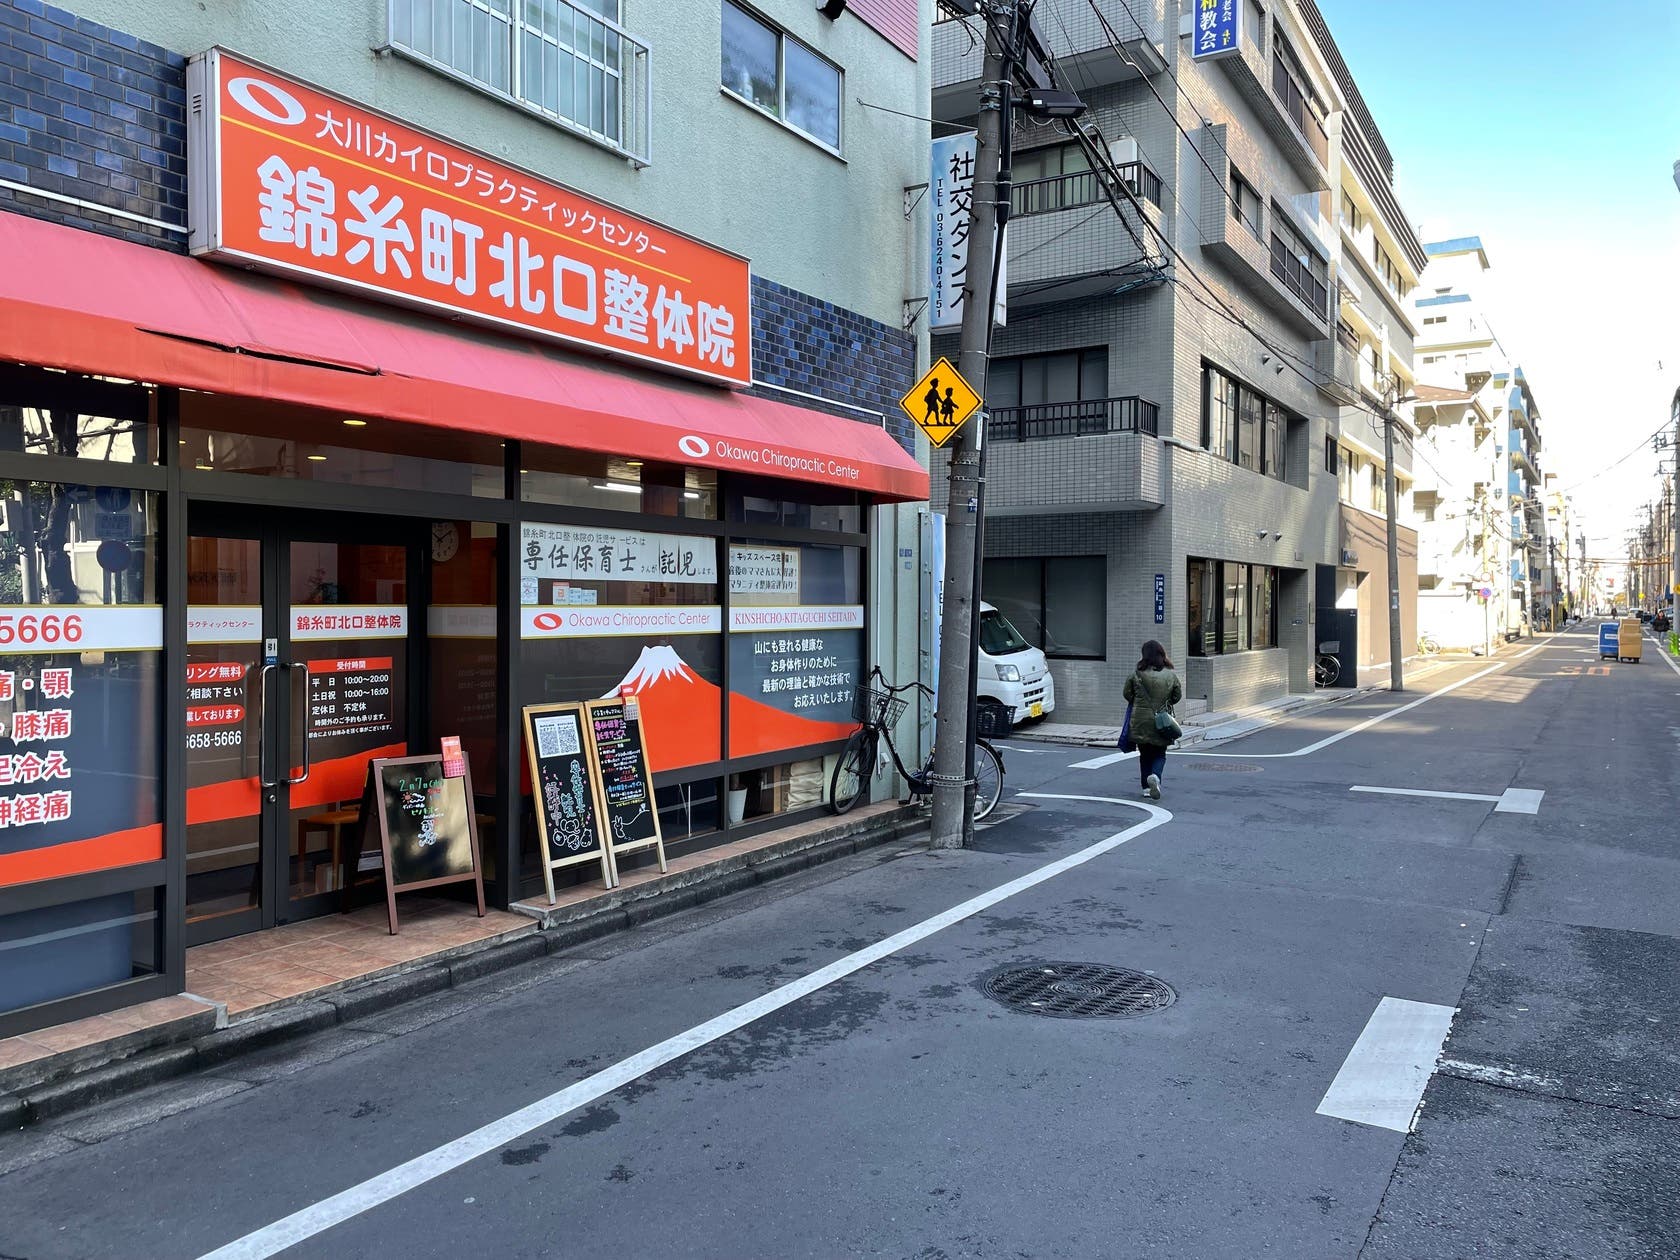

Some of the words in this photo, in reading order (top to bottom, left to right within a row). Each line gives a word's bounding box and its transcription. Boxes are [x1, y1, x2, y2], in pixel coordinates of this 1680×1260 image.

[315, 110, 667, 255] 大川カイロプラクティックセンター
[256, 154, 735, 368] 錦糸町北口整体院
[715, 440, 760, 464] Okawa
[761, 448, 827, 474] Chiropractic
[827, 460, 860, 480] Center
[296, 615, 402, 631] 錦糸町北口整体院
[568, 613, 611, 627] Okawa
[612, 612, 677, 628] Chiropractic
[678, 612, 711, 626] Center
[735, 612, 827, 625] KINSHICHO-KITAGUCHI
[0, 615, 83, 643] 5666
[754, 638, 824, 655] 山にも登れる健康な
[336, 660, 367, 671] 受付時間
[770, 656, 837, 673] お身体作りのために
[762, 672, 851, 693] 最新の理論と確かな技術で
[311, 690, 337, 702] 土日祝
[311, 704, 336, 716] 定休日
[343, 702, 367, 713] 不定休
